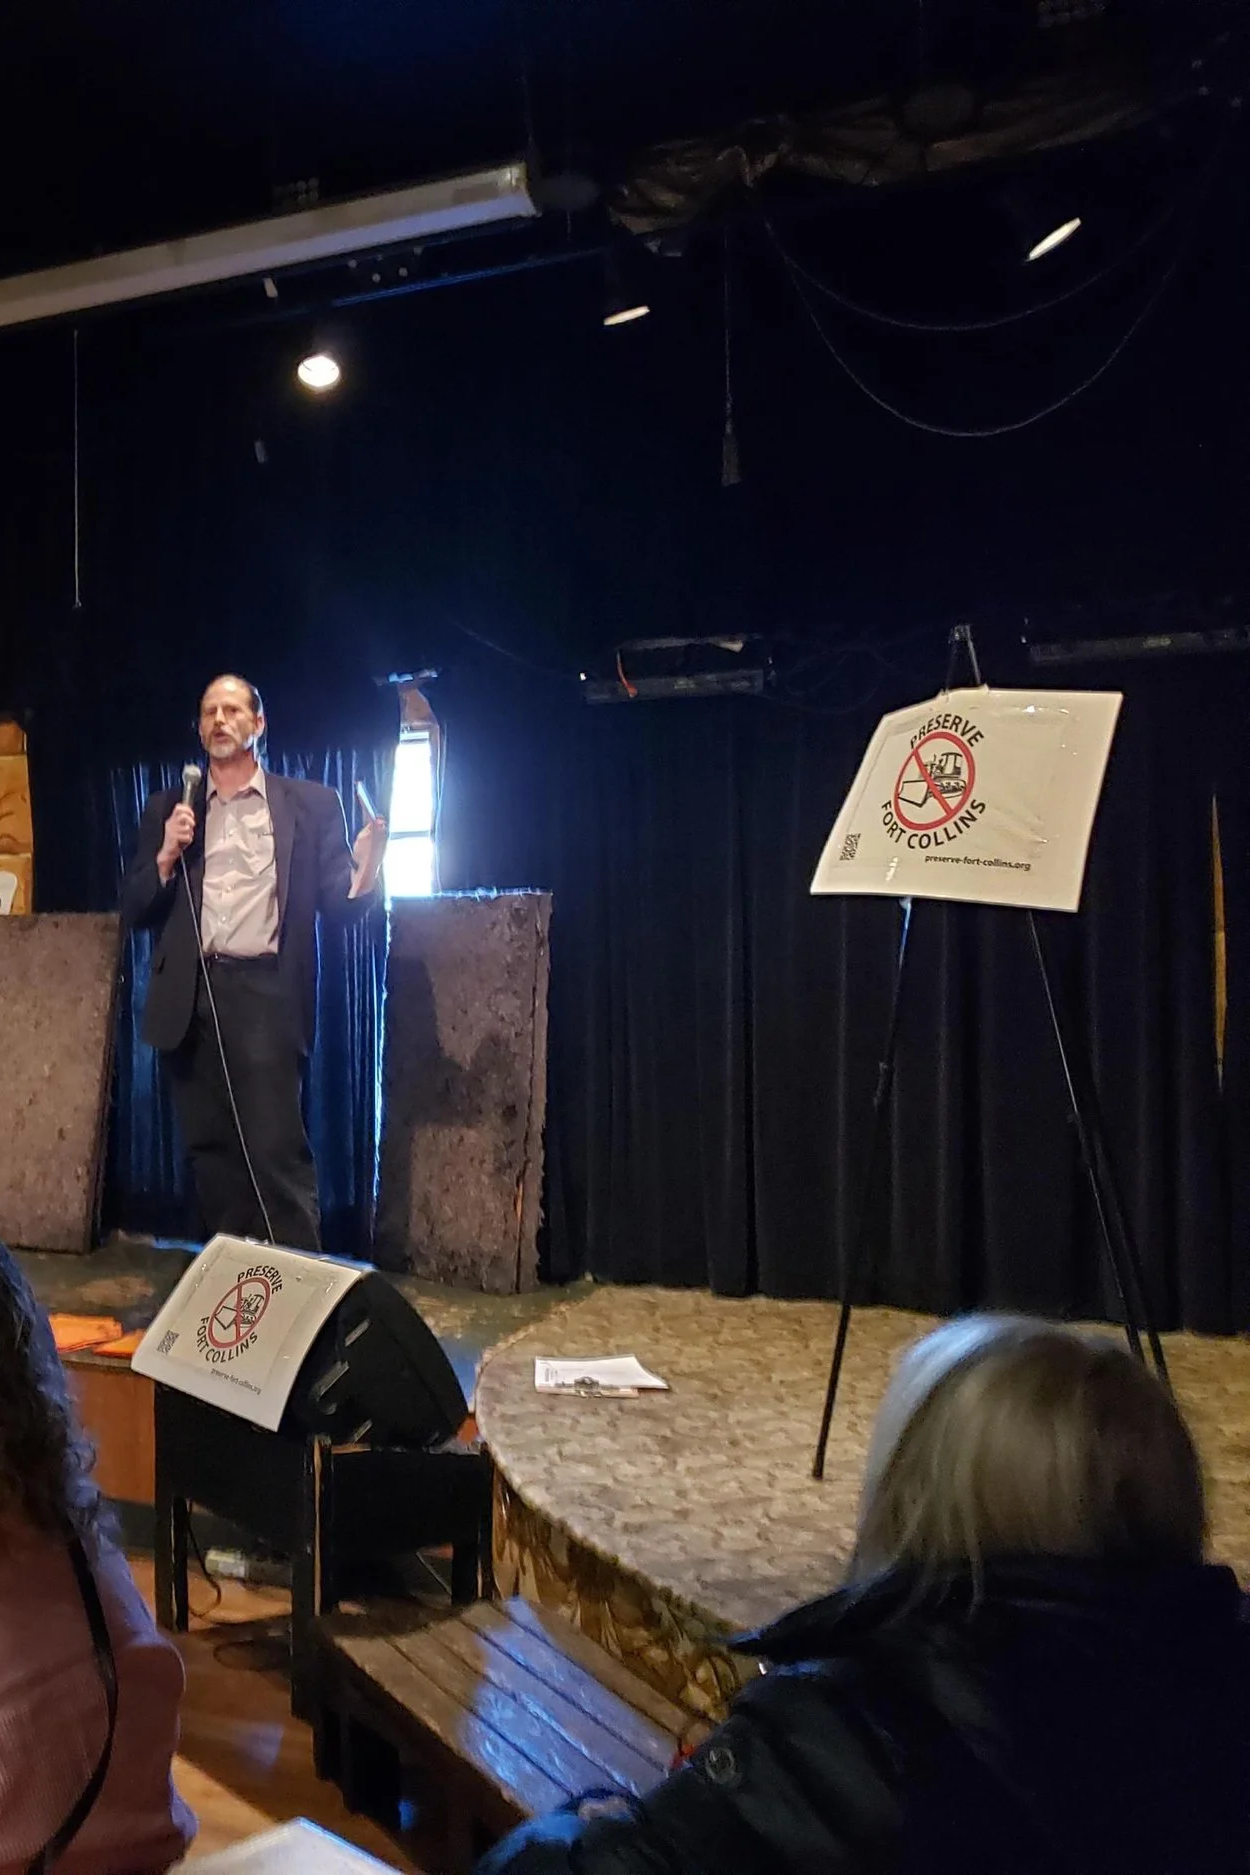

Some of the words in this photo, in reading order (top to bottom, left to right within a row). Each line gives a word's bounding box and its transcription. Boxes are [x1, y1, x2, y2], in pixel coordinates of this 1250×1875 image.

[910, 713, 984, 749] PRESERVE
[881, 800, 906, 843] FORT
[907, 799, 986, 849] COLLINS
[924, 853, 1031, 871] preserve-fort-collins.org
[237, 1265, 283, 1295] PRESERVE
[196, 1316, 210, 1353] FORT
[205, 1331, 258, 1363] COLLINS
